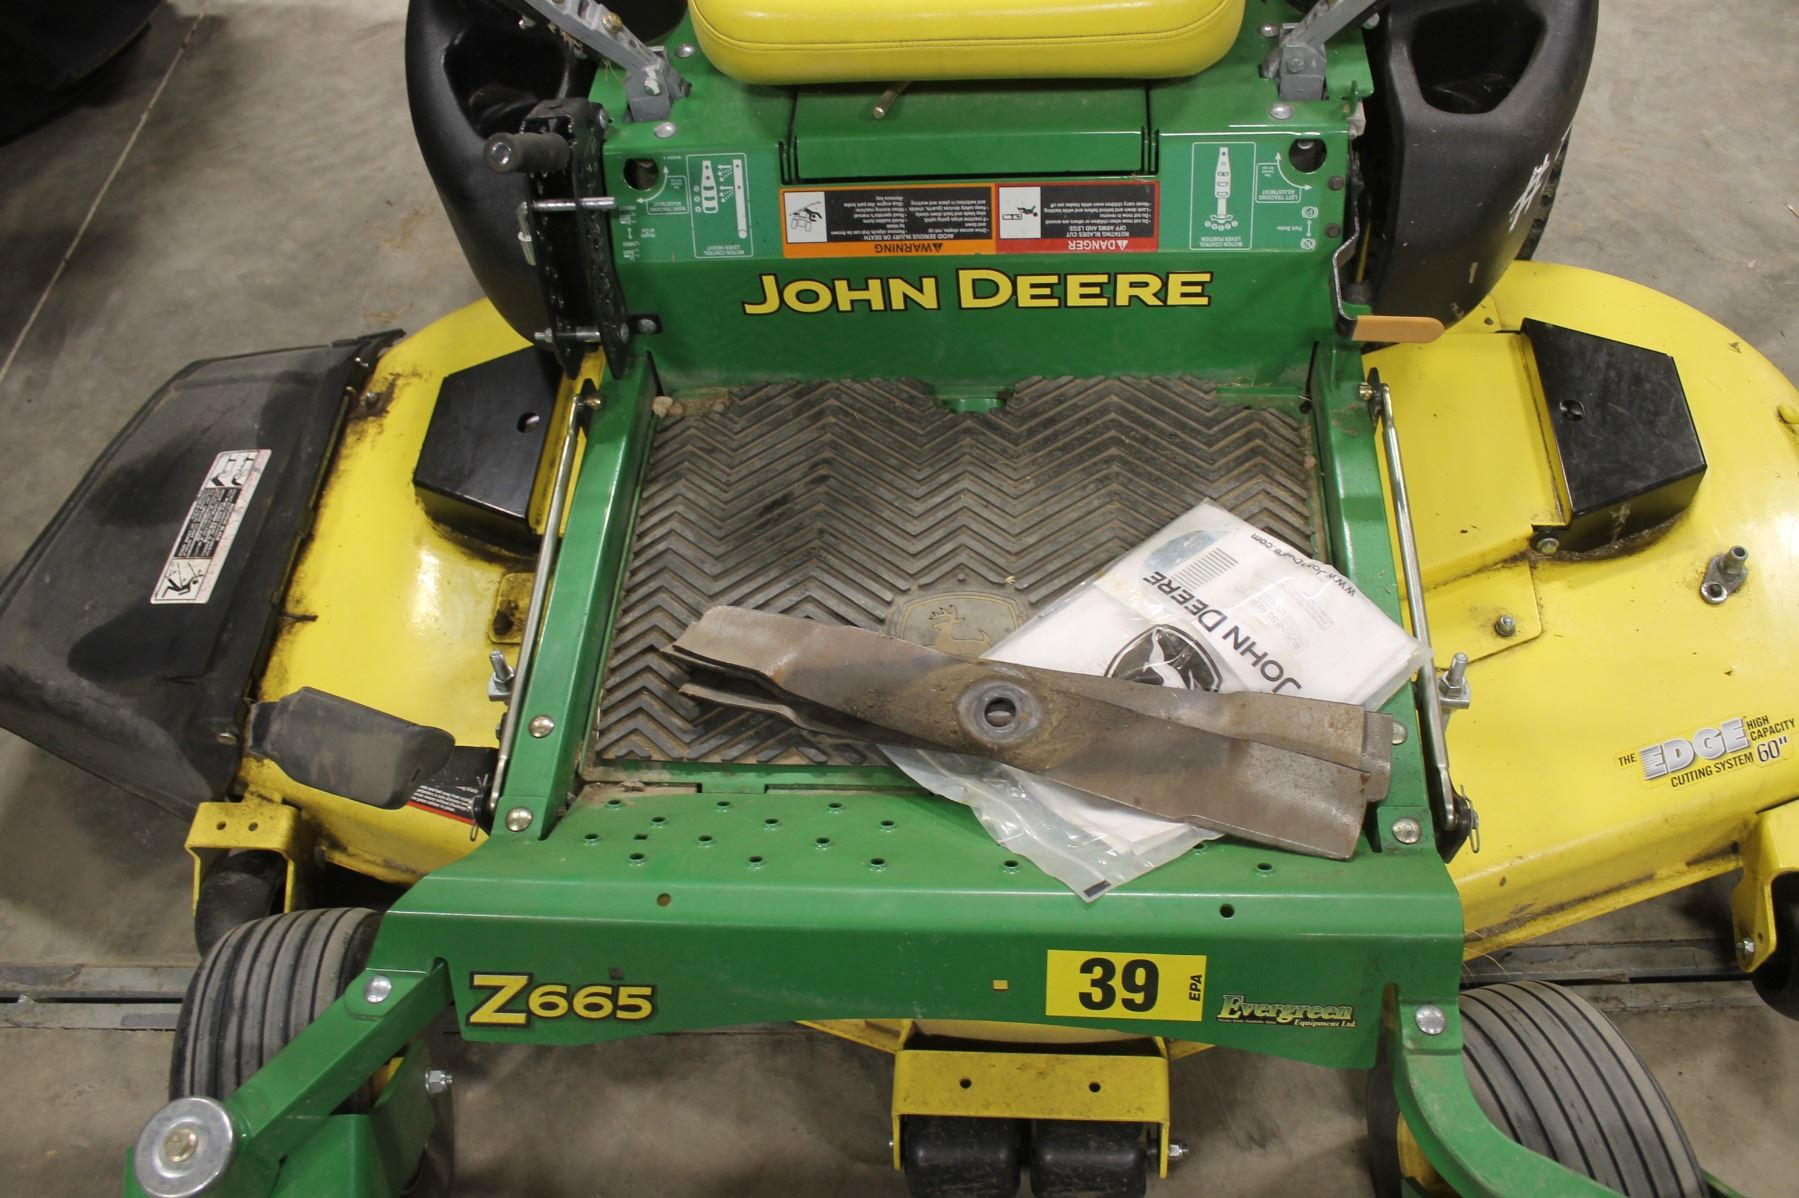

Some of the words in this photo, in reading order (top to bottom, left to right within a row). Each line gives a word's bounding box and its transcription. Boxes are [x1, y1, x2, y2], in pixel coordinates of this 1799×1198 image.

[874, 243, 932, 253] WARNING
[1068, 240, 1116, 250] DANGER
[743, 273, 940, 315] JOHN
[957, 268, 1213, 309] DEERE
[1143, 571, 1228, 633] DEERE
[1222, 625, 1302, 693] JOHN
[1746, 715, 1769, 730] HIGH
[1750, 718, 1795, 741] CAPACITY
[1618, 753, 1637, 767] THE
[1639, 716, 1751, 780] EDGE
[1671, 765, 1713, 788] CUTTING
[1714, 752, 1754, 774] SYSTEM
[1757, 736, 1787, 762] 60"
[467, 972, 654, 1026] Z665
[1079, 957, 1159, 1012] 39
[1189, 974, 1202, 1001] EPA
[1217, 994, 1353, 1023] Evergreen
[1294, 1019, 1339, 1028] Equipment
